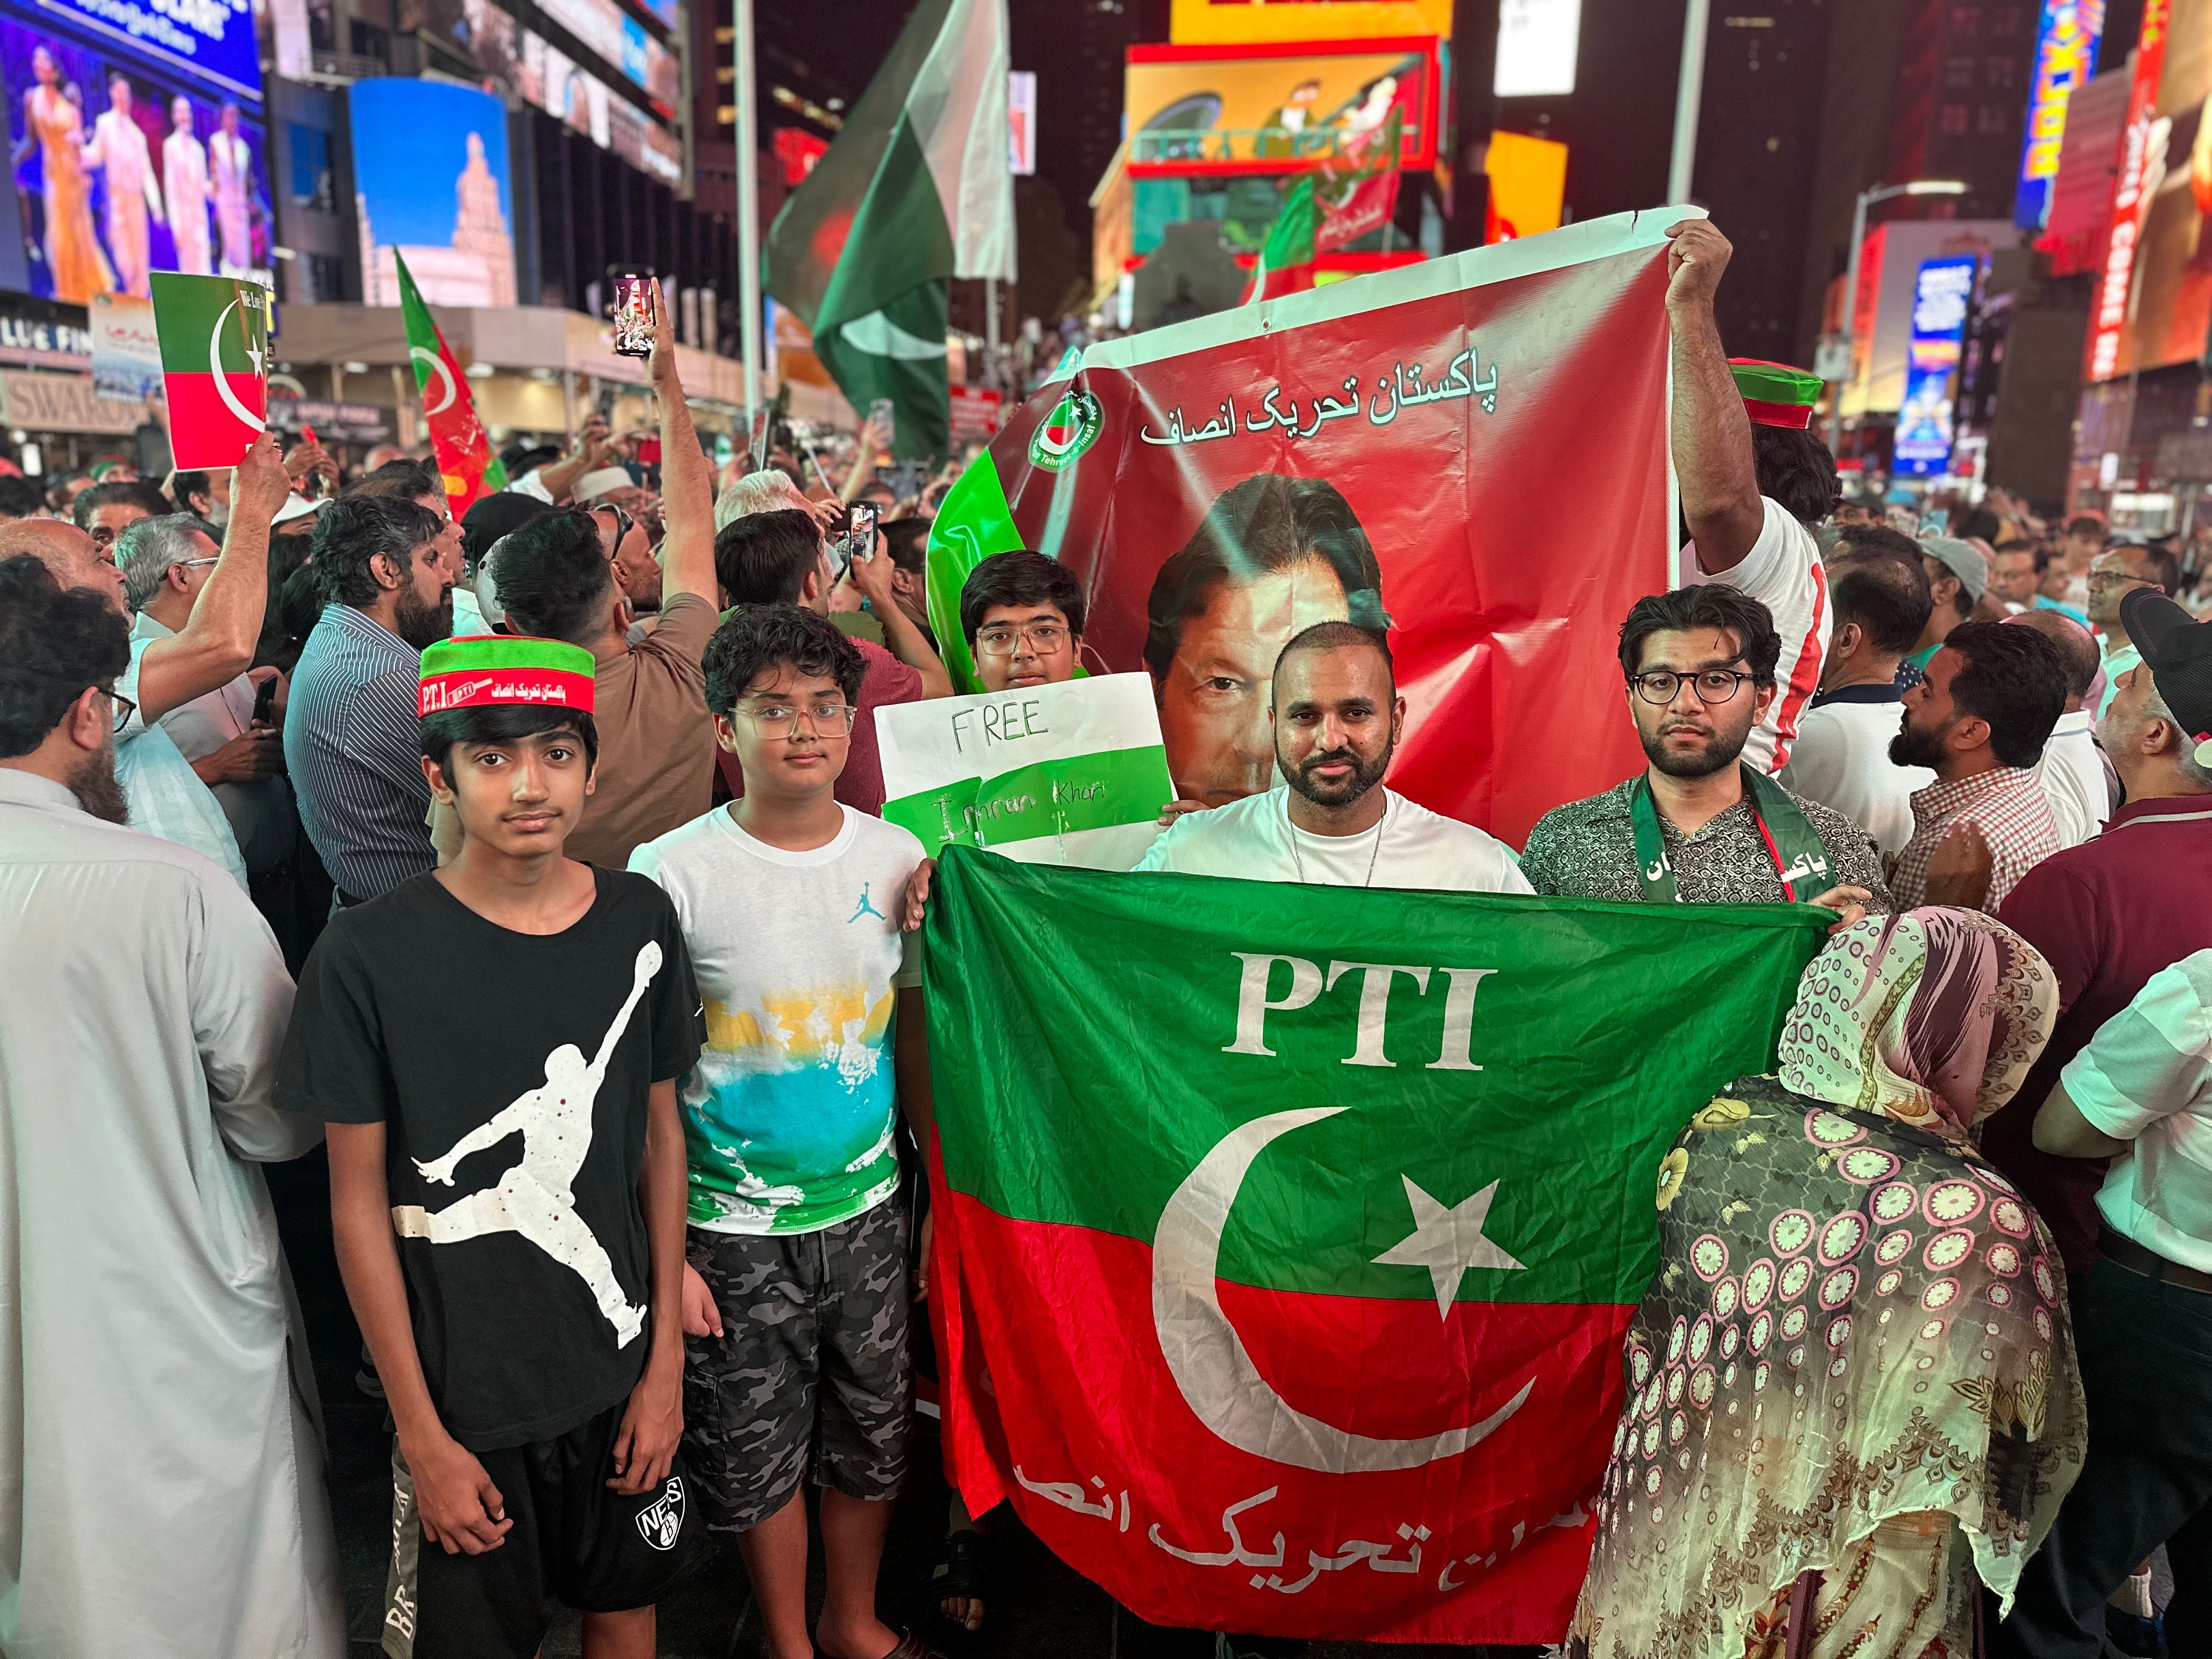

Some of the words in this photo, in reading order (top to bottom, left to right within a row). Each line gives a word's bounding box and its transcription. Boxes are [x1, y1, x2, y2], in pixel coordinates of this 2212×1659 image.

[1246, 376, 1360, 439] تحریک
[1371, 348, 1497, 425] پاکستان
[1141, 396, 1236, 445] انصاف
[457, 685, 473, 699] PTI
[951, 700, 1049, 755] FREE
[1221, 951, 1499, 1071] PTI
[641, 1482, 681, 1537] NES
[1148, 1485, 1432, 1594] تحریک
